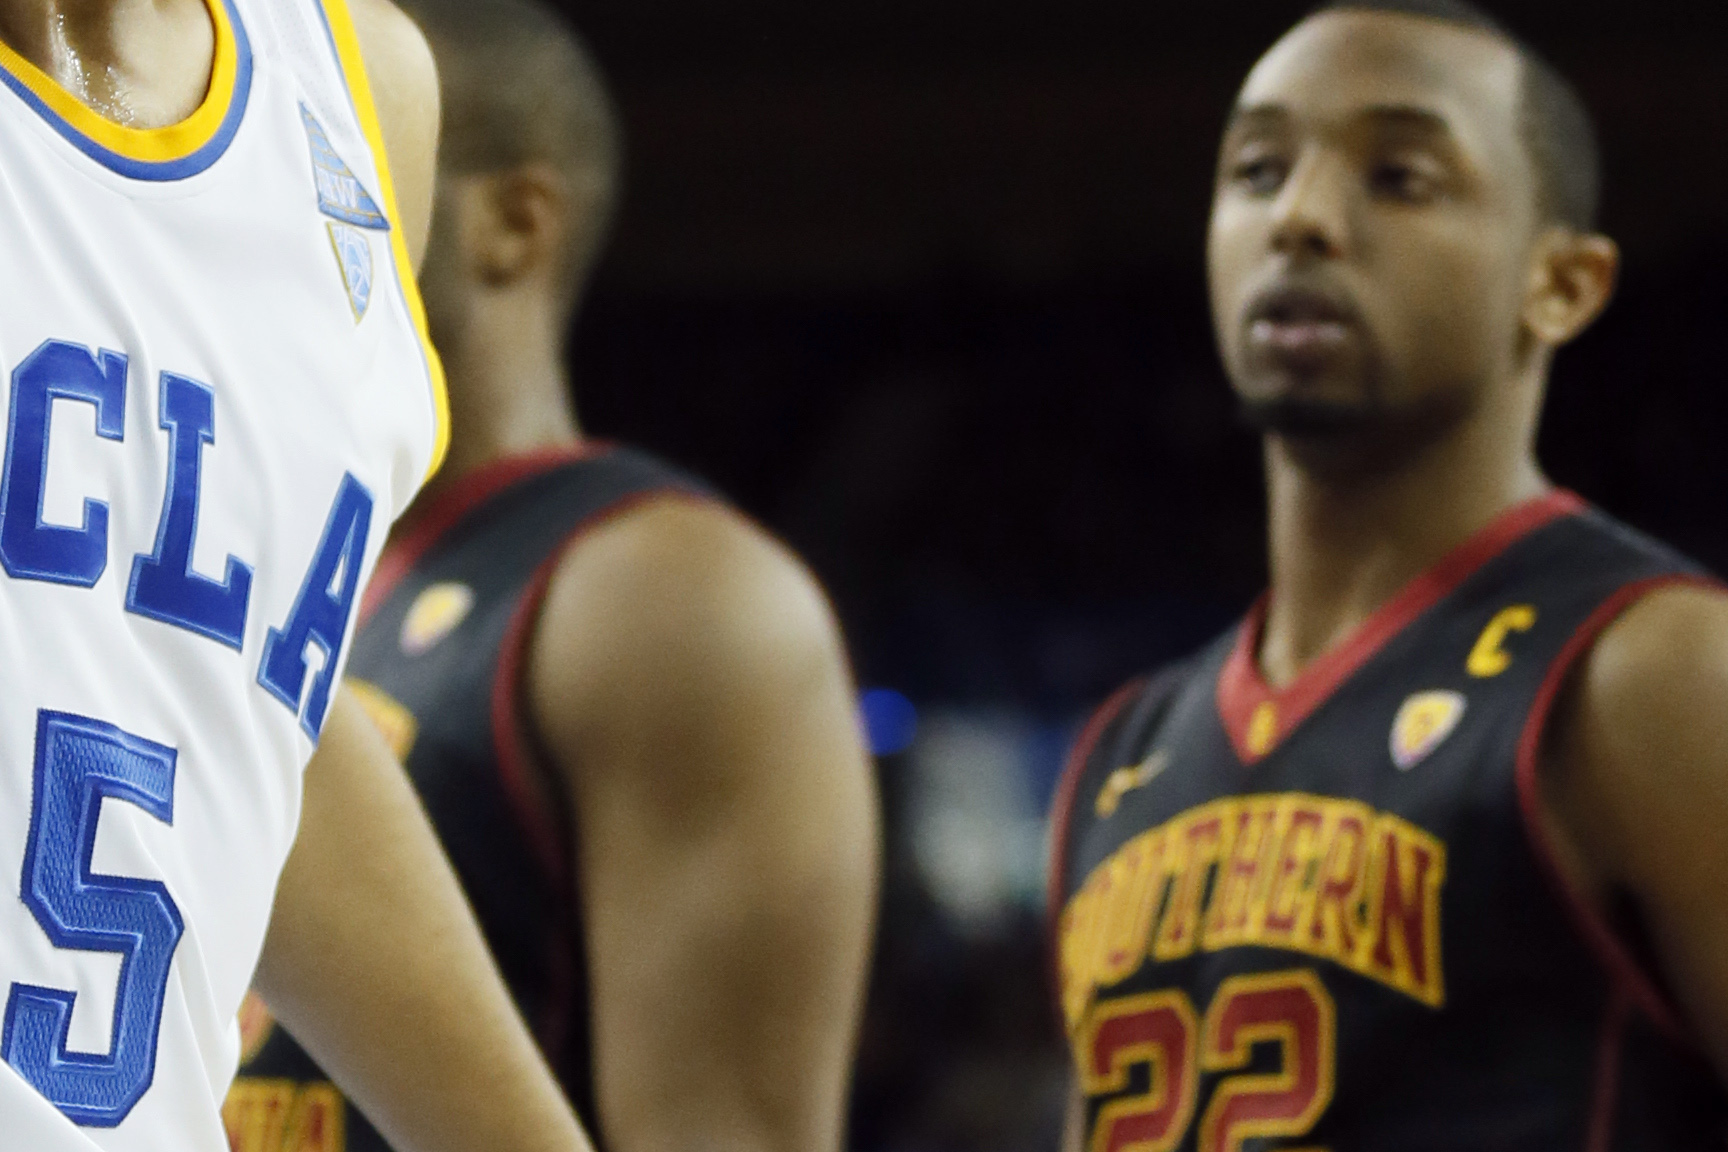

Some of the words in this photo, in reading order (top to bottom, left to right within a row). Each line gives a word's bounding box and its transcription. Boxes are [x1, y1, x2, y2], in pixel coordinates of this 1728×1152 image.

[1465, 602, 1538, 679] C
[0, 709, 186, 1128] 5
[1078, 968, 1336, 1152] 22
